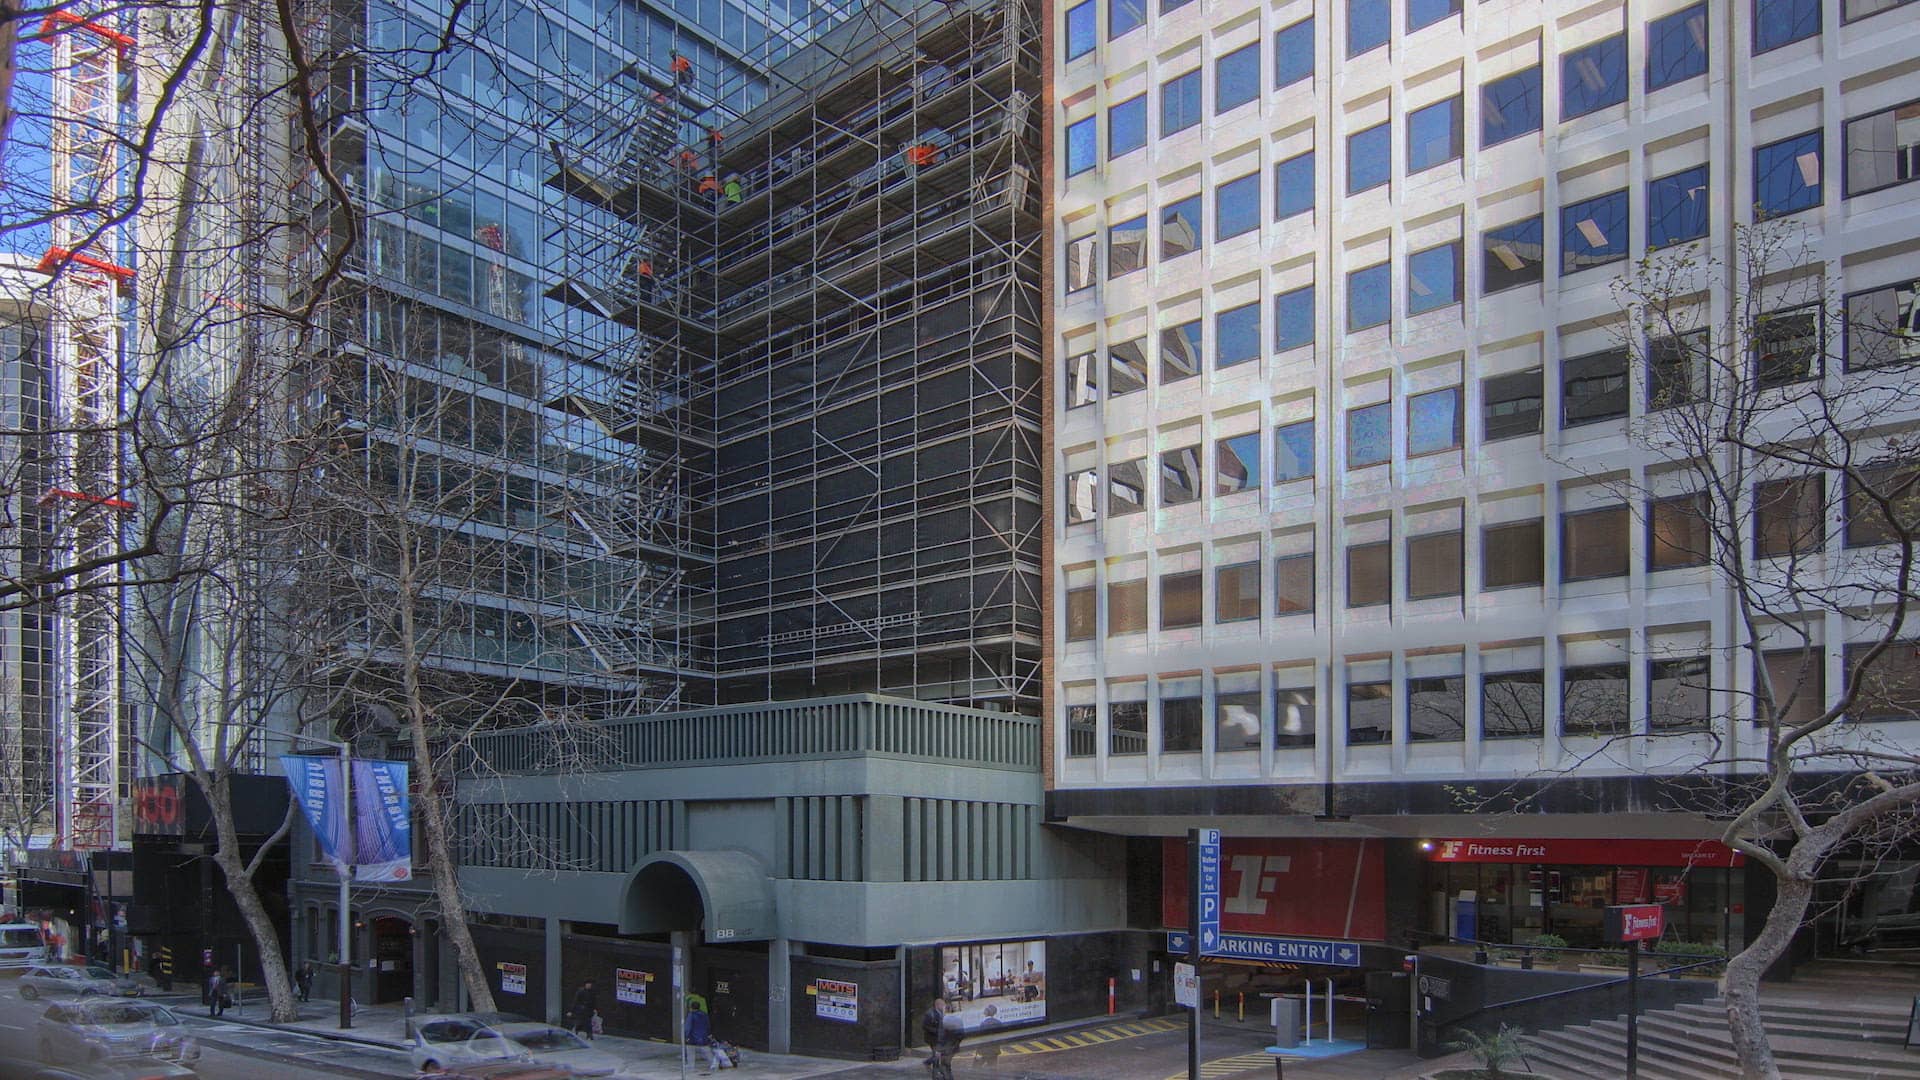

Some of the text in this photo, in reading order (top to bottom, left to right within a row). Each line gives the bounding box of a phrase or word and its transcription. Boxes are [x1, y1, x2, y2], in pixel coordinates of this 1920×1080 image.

[1205, 898, 1215, 918] P
[1219, 939, 1328, 959] ARKING ENTRY
